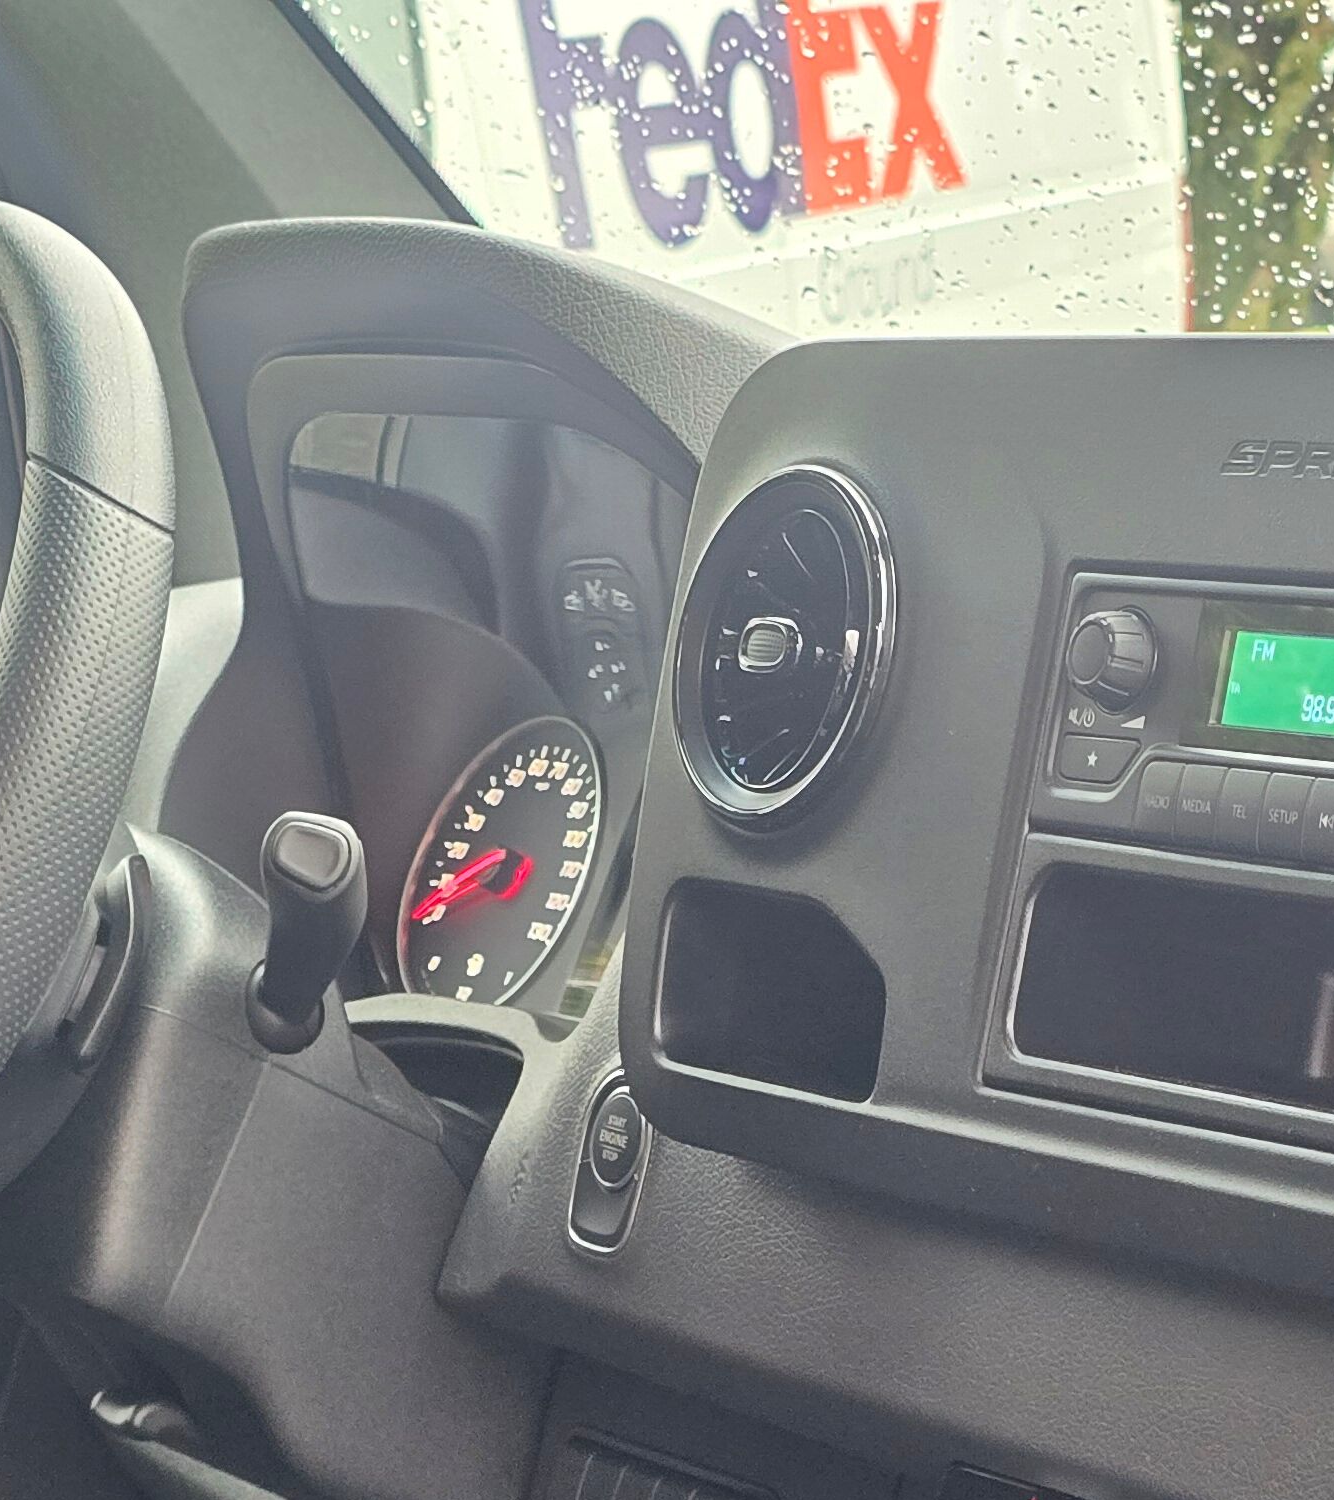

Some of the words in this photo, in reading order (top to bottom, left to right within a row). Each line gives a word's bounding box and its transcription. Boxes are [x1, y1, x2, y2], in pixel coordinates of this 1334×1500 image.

[1251, 638, 1277, 662] FM
[1181, 797, 1212, 815] MEDIA
[1231, 803, 1248, 820] TEL
[1267, 807, 1300, 826] SETUP
[598, 1128, 629, 1149] ENGINE
